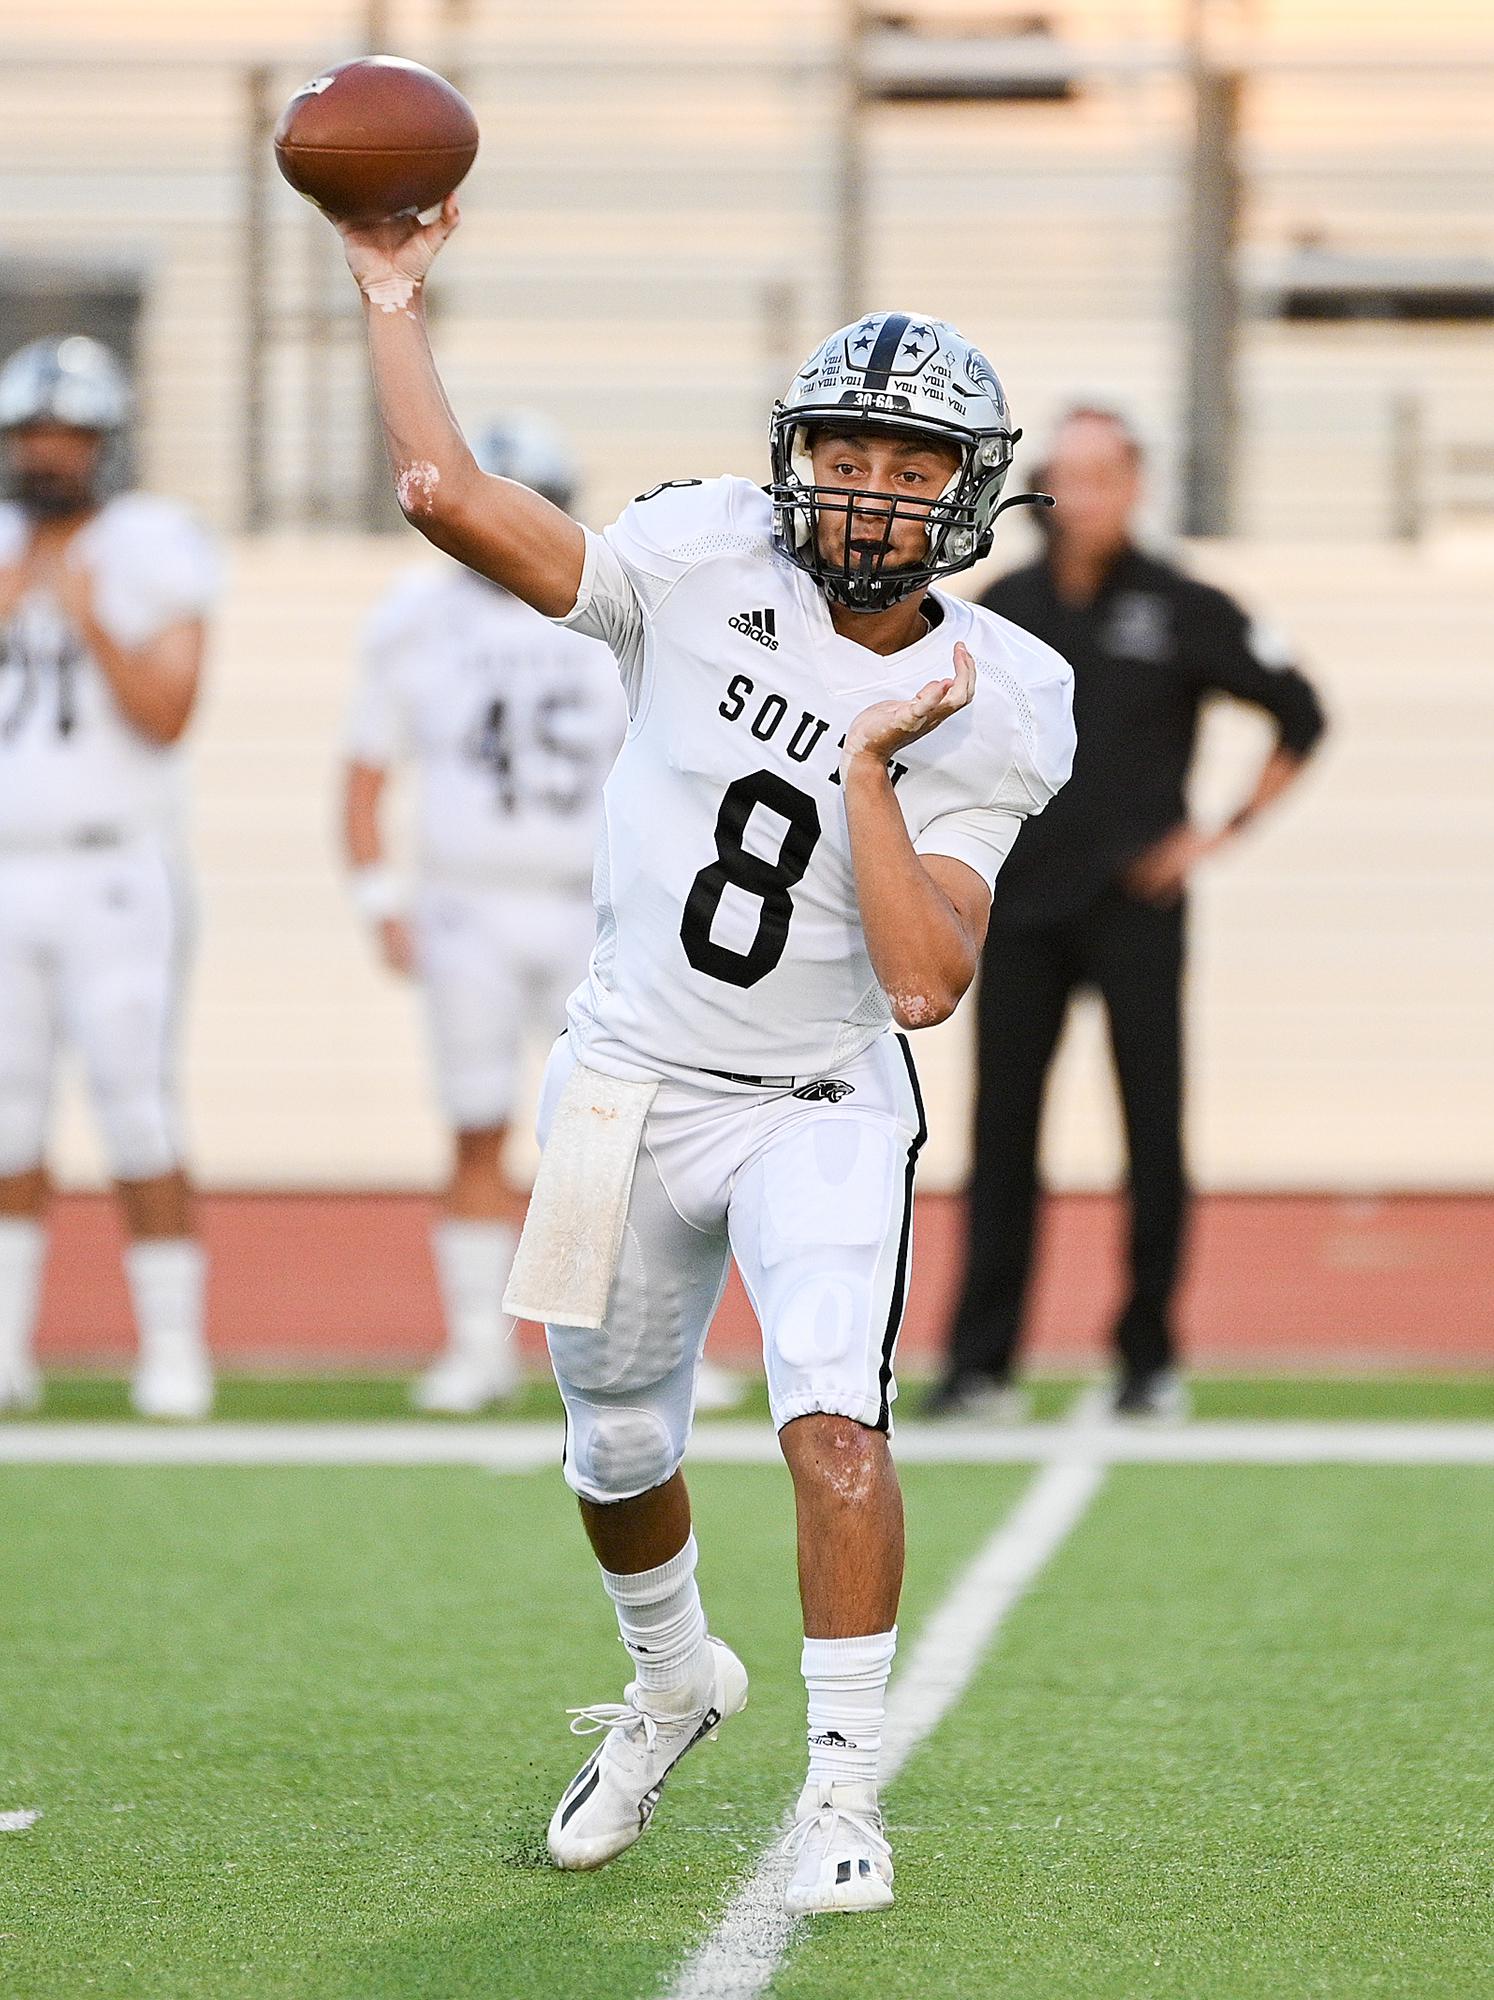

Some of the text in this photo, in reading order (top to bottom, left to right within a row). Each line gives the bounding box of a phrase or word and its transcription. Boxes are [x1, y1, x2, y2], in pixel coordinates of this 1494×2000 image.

[728, 617, 780, 652] adidas
[460, 690, 595, 816] 45
[719, 673, 909, 788] SOU
[679, 768, 822, 990] 8
